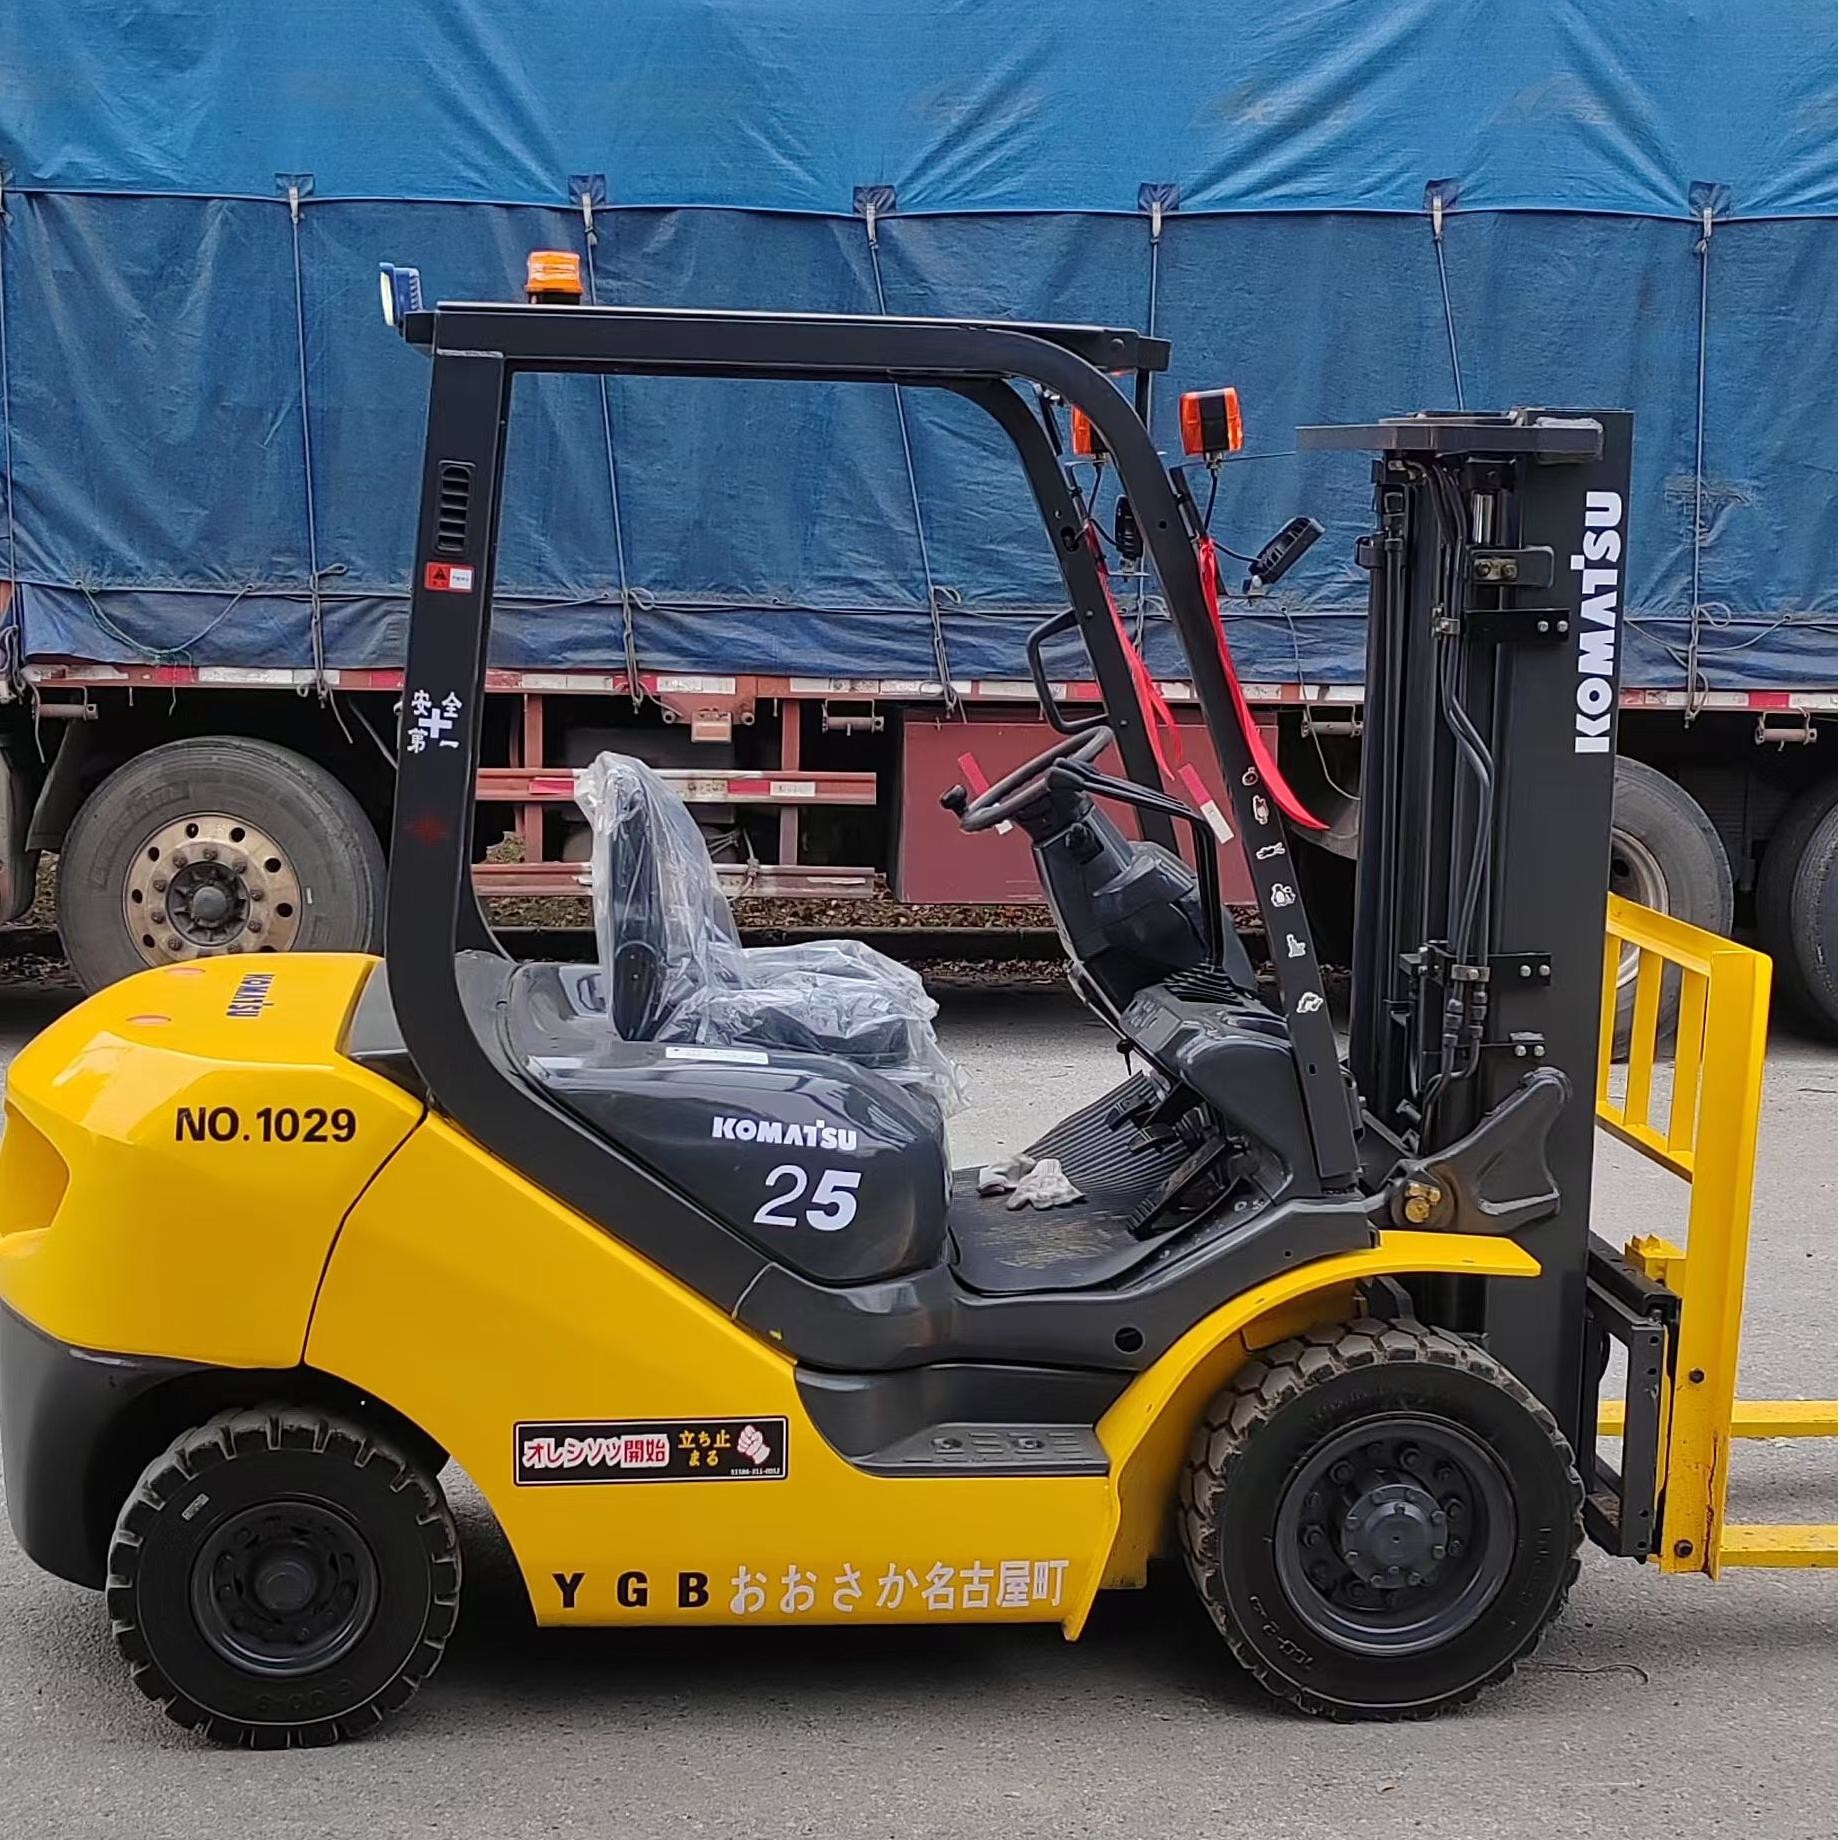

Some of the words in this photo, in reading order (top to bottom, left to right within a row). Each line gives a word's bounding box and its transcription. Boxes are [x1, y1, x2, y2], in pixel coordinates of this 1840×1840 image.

[1570, 491, 1623, 753] KOMATSU
[411, 690, 463, 717] 安全
[407, 727, 460, 754] 第一
[226, 973, 275, 1018] KOMATSU
[711, 1116, 858, 1151] KOMATSU
[753, 1164, 862, 1232] 25
[730, 1559, 1069, 1614] おおさか名古屋町
